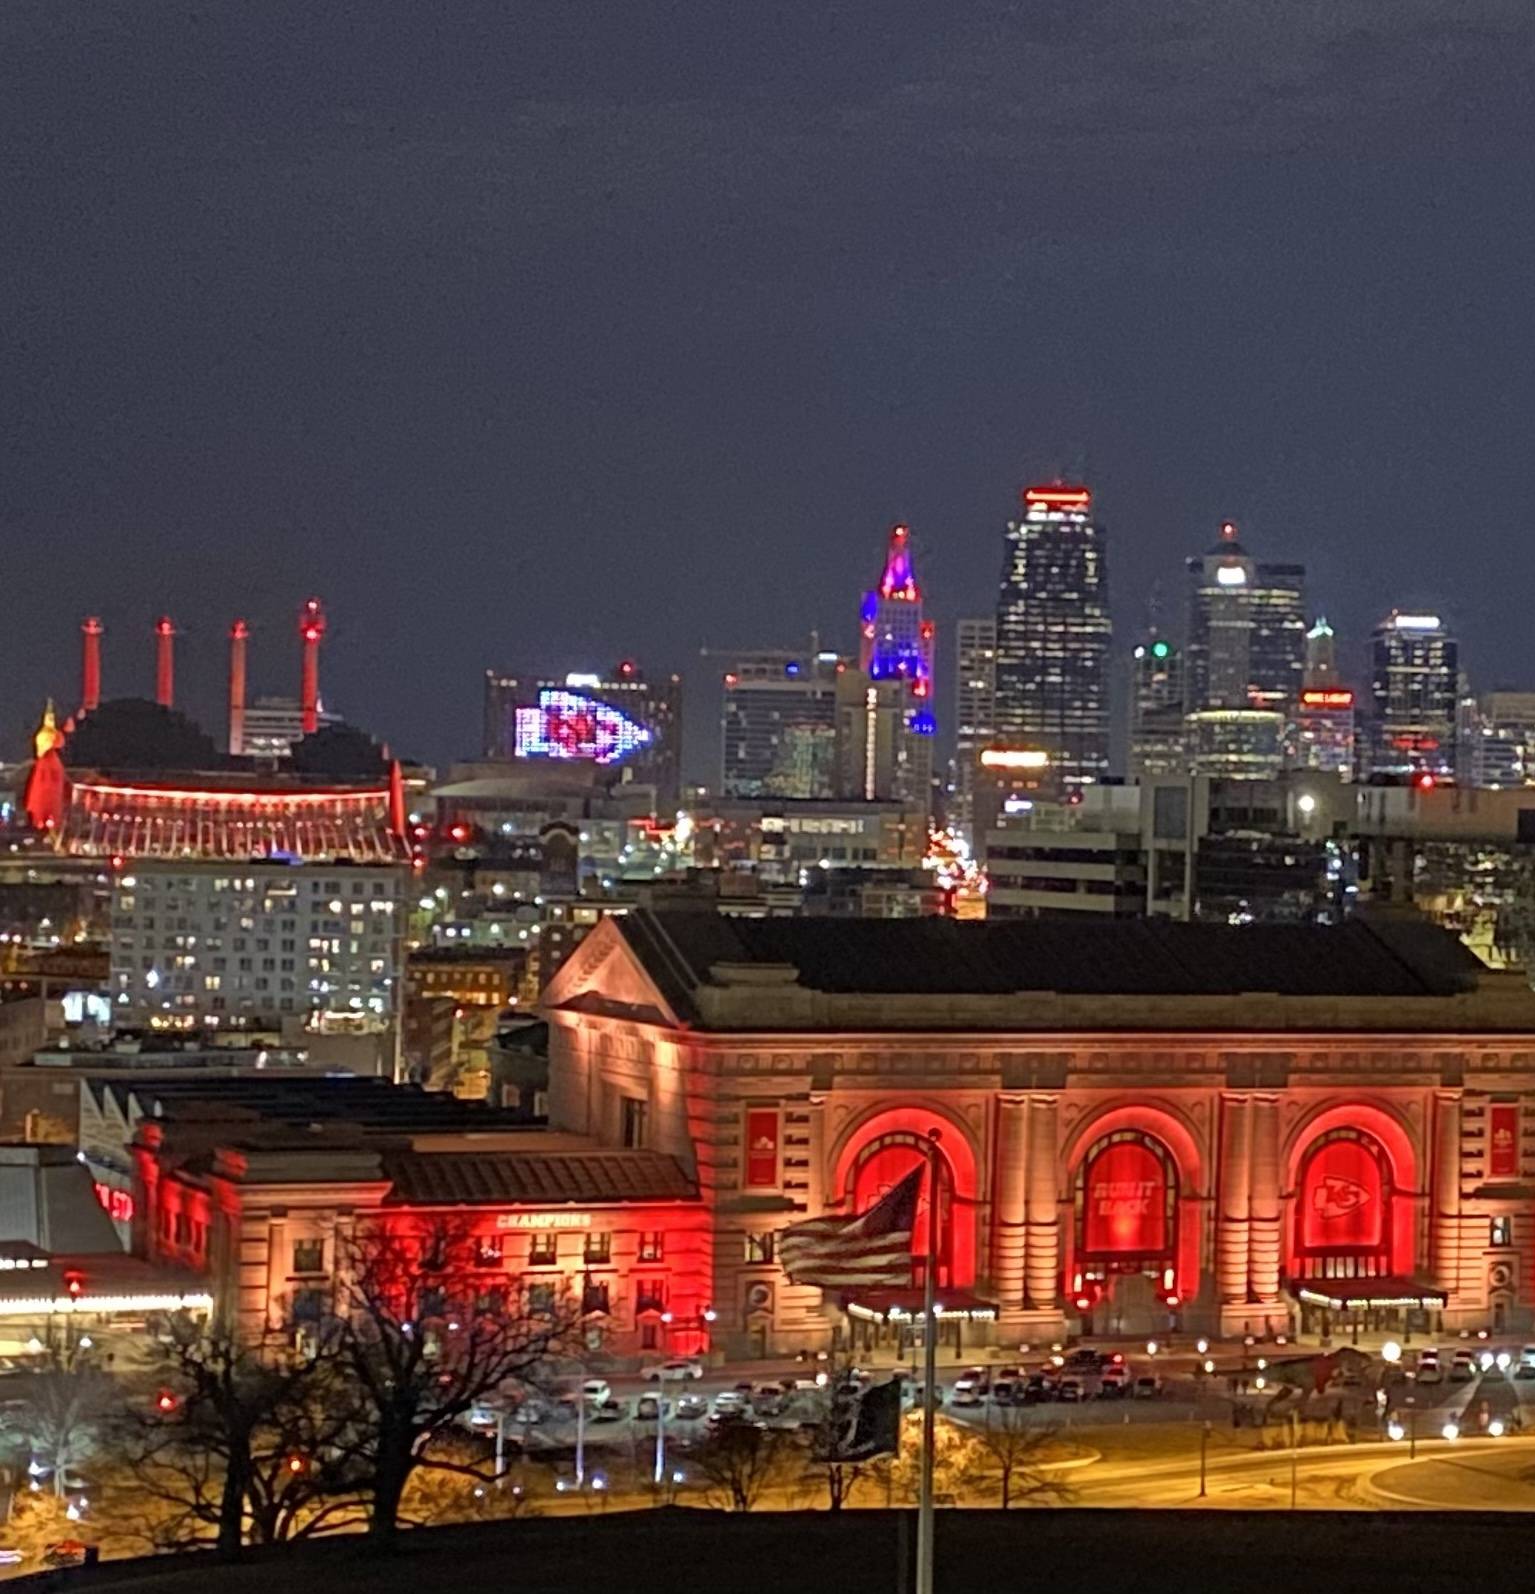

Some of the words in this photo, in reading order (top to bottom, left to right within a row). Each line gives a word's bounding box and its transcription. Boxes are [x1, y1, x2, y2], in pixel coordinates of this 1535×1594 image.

[1094, 1182, 1138, 1198] RUN
[1099, 1199, 1151, 1215] BACK
[496, 1212, 592, 1229] CHAMPIONS
